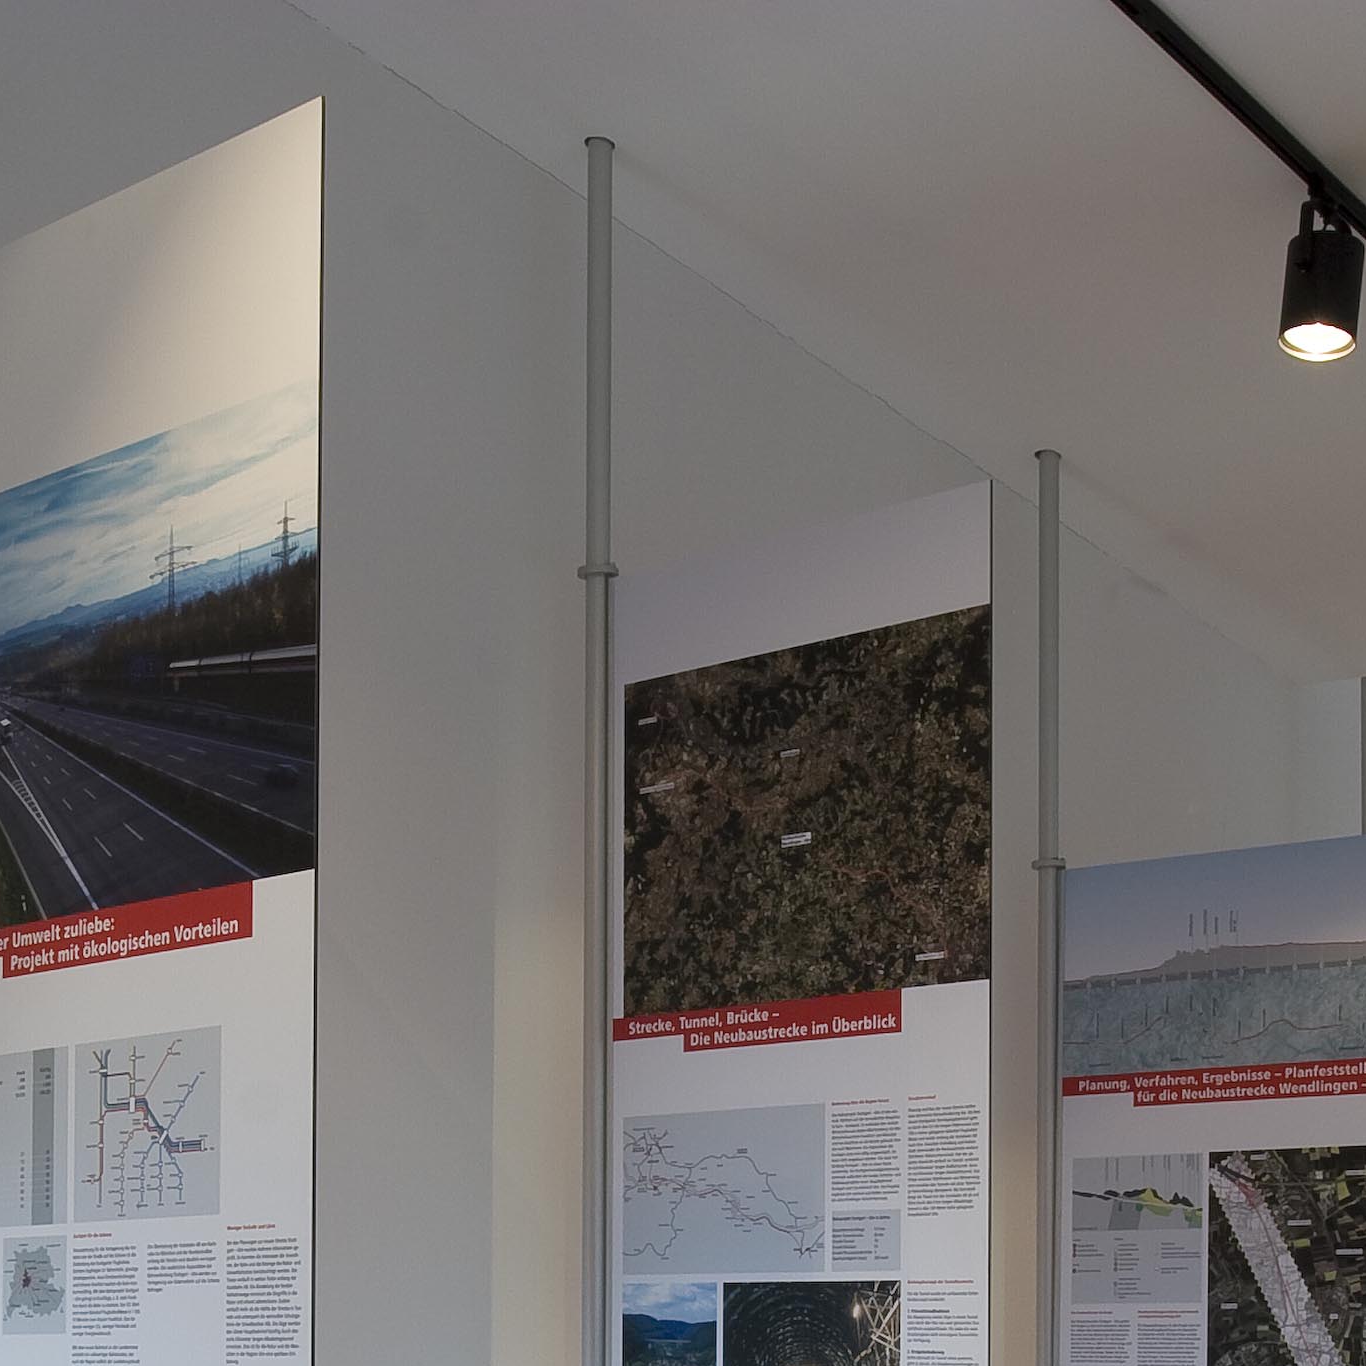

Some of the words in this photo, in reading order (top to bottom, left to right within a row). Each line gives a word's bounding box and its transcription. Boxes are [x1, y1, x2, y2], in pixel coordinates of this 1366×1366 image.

[10, 948, 55, 972] Projekt
[57, 943, 80, 963] mit
[82, 930, 171, 958] ökologischen
[173, 917, 239, 942] Vorteilen
[12, 924, 61, 948] Umwelt
[63, 916, 115, 939] zuliebe:
[628, 1018, 675, 1035] Strecke,
[679, 1011, 723, 1029] Tunnel,
[726, 1008, 769, 1025] Brücke
[690, 1032, 711, 1046] Die
[714, 1022, 808, 1045] Neubaustrecke
[811, 1021, 828, 1035] im
[832, 1013, 897, 1034] Überblick
[1078, 1079, 1131, 1092] Planung,
[1134, 1074, 1198, 1088] Verfahren,
[1202, 1069, 1271, 1086] Ergebnisse
[1136, 1090, 1155, 1103] für
[1158, 1089, 1178, 1101] die
[1181, 1083, 1276, 1100] Neubaustrecke
[1278, 1080, 1358, 1095] Wendlingen
